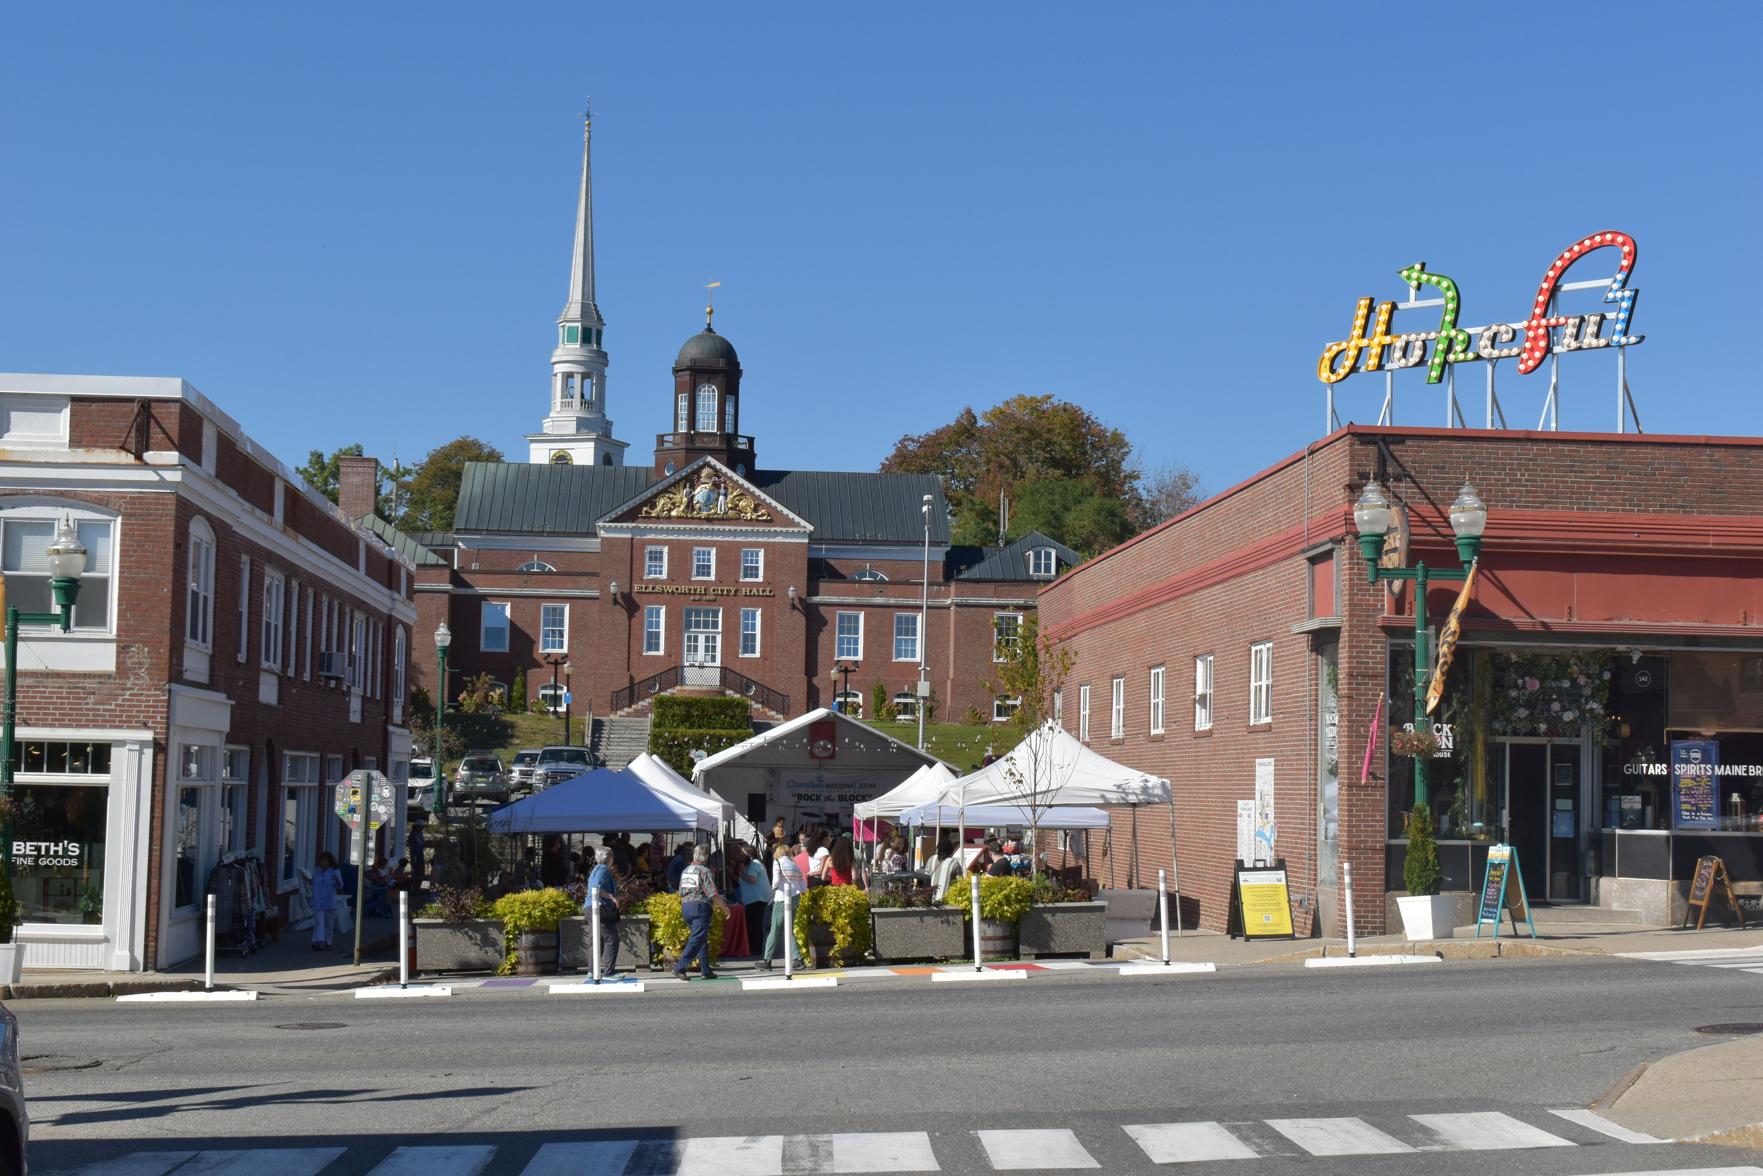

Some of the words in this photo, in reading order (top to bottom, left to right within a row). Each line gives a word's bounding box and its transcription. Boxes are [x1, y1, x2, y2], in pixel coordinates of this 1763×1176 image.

[1317, 229, 1645, 384] Hopeful
[633, 583, 705, 594] ELLSWORTH
[710, 585, 737, 595] CITY
[742, 587, 774, 596] HALL
[1403, 722, 1453, 736] BCK
[1623, 763, 1667, 775] GUITARS
[1674, 763, 1712, 775] SPIRITS
[1714, 764, 1748, 776] MAINE
[1748, 764, 1763, 776] BR
[12, 840, 80, 856] BETH'S
[38, 857, 78, 866] GOODS
